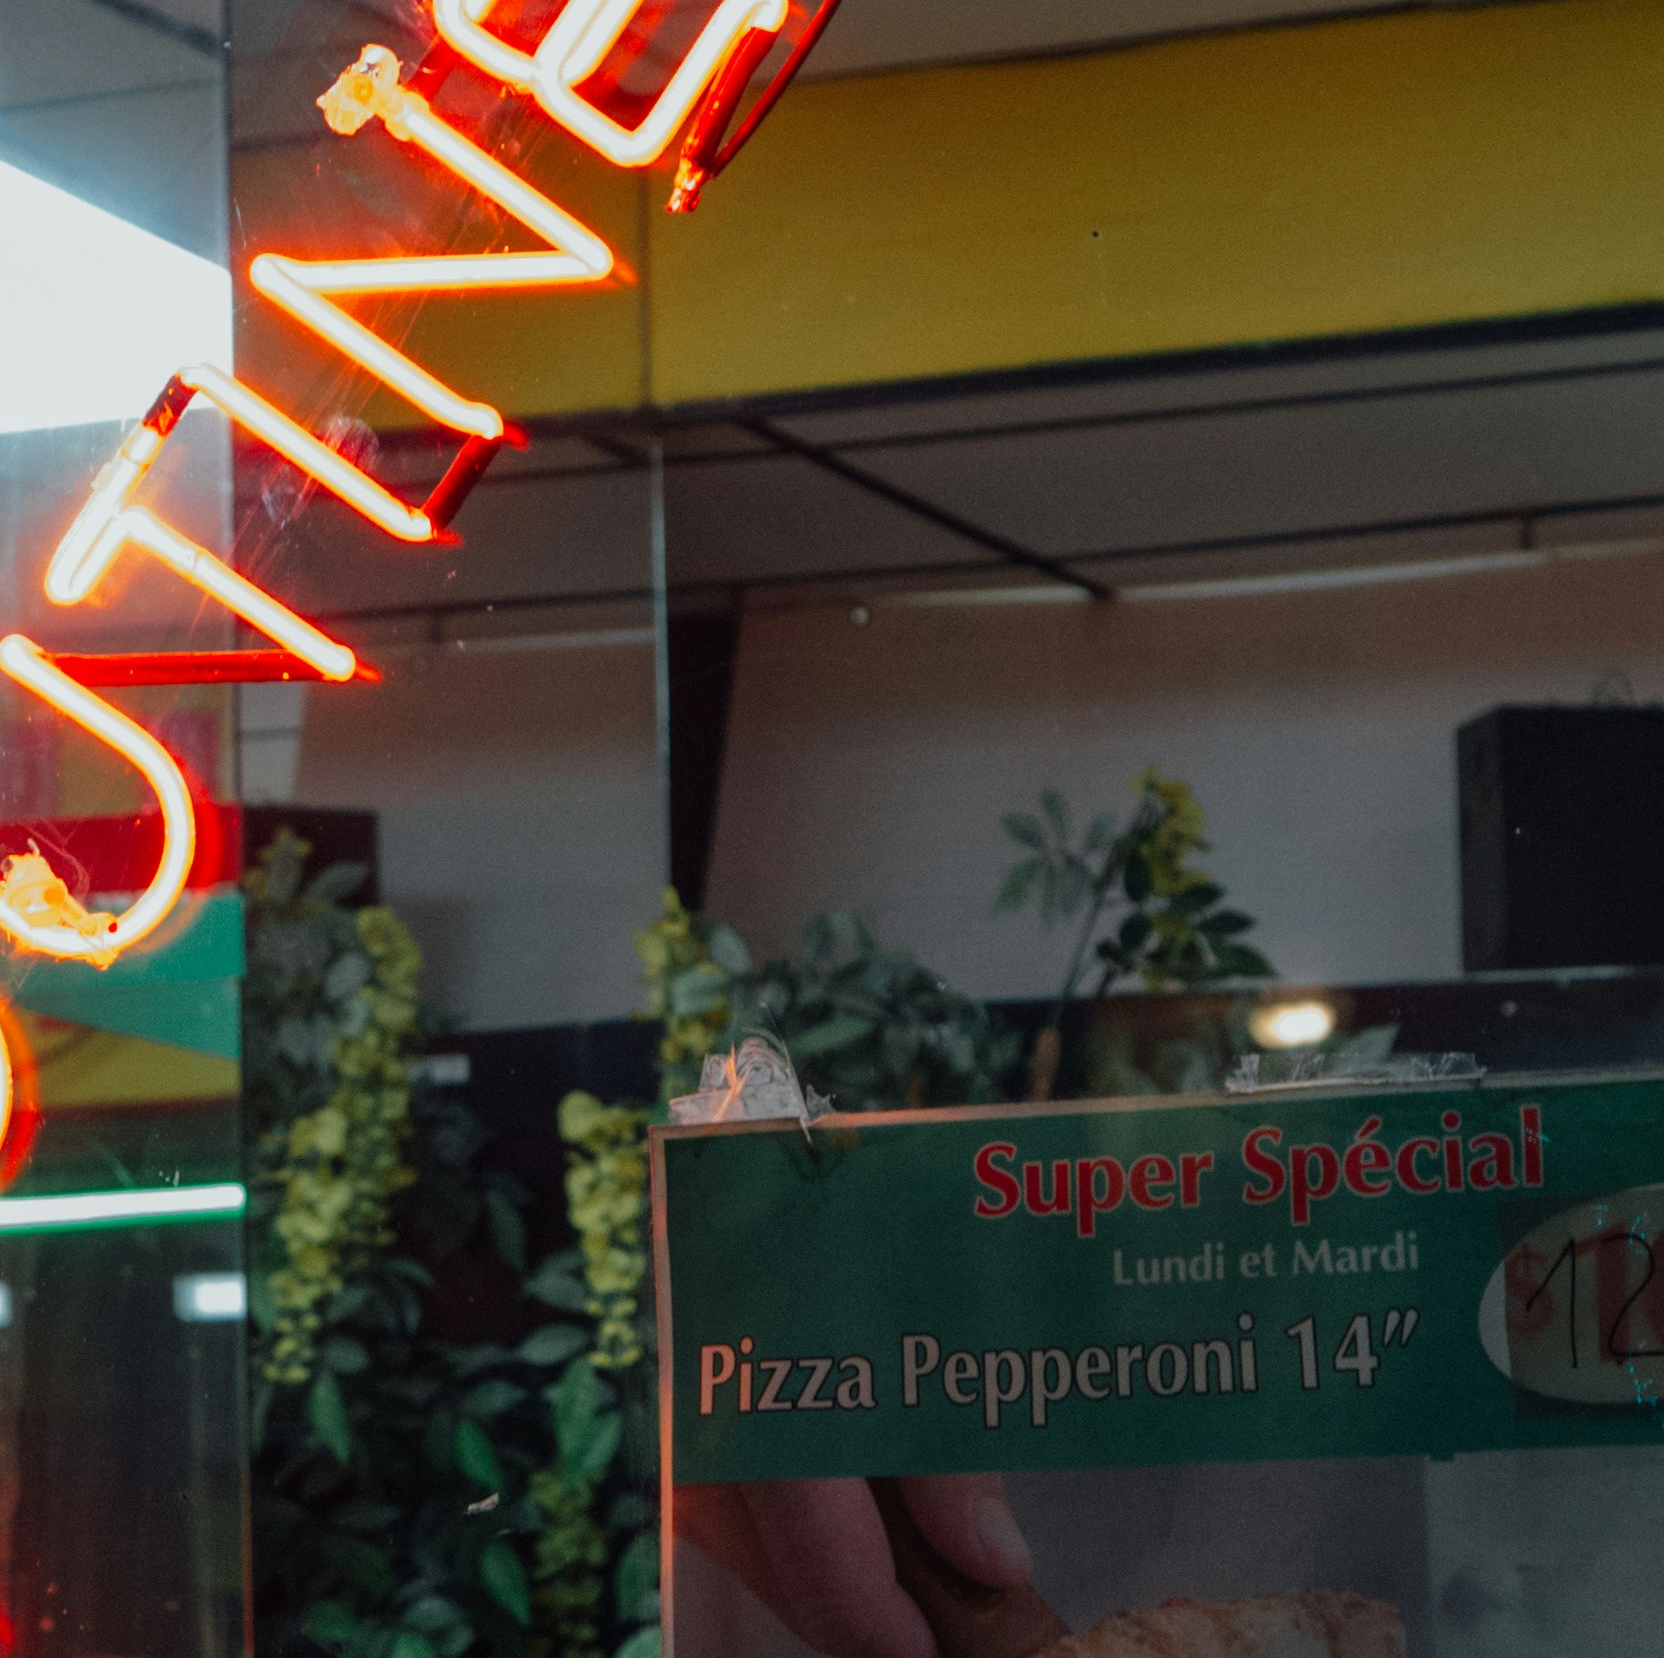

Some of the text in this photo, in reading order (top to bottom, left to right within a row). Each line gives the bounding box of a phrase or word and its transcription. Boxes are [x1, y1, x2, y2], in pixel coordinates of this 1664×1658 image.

[972, 1104, 1545, 1239] Super Spécial
[1112, 1231, 1420, 1287] Lundi et Mardi
[696, 1336, 877, 1416] Pizza
[900, 1311, 1260, 1430] Pepperoni
